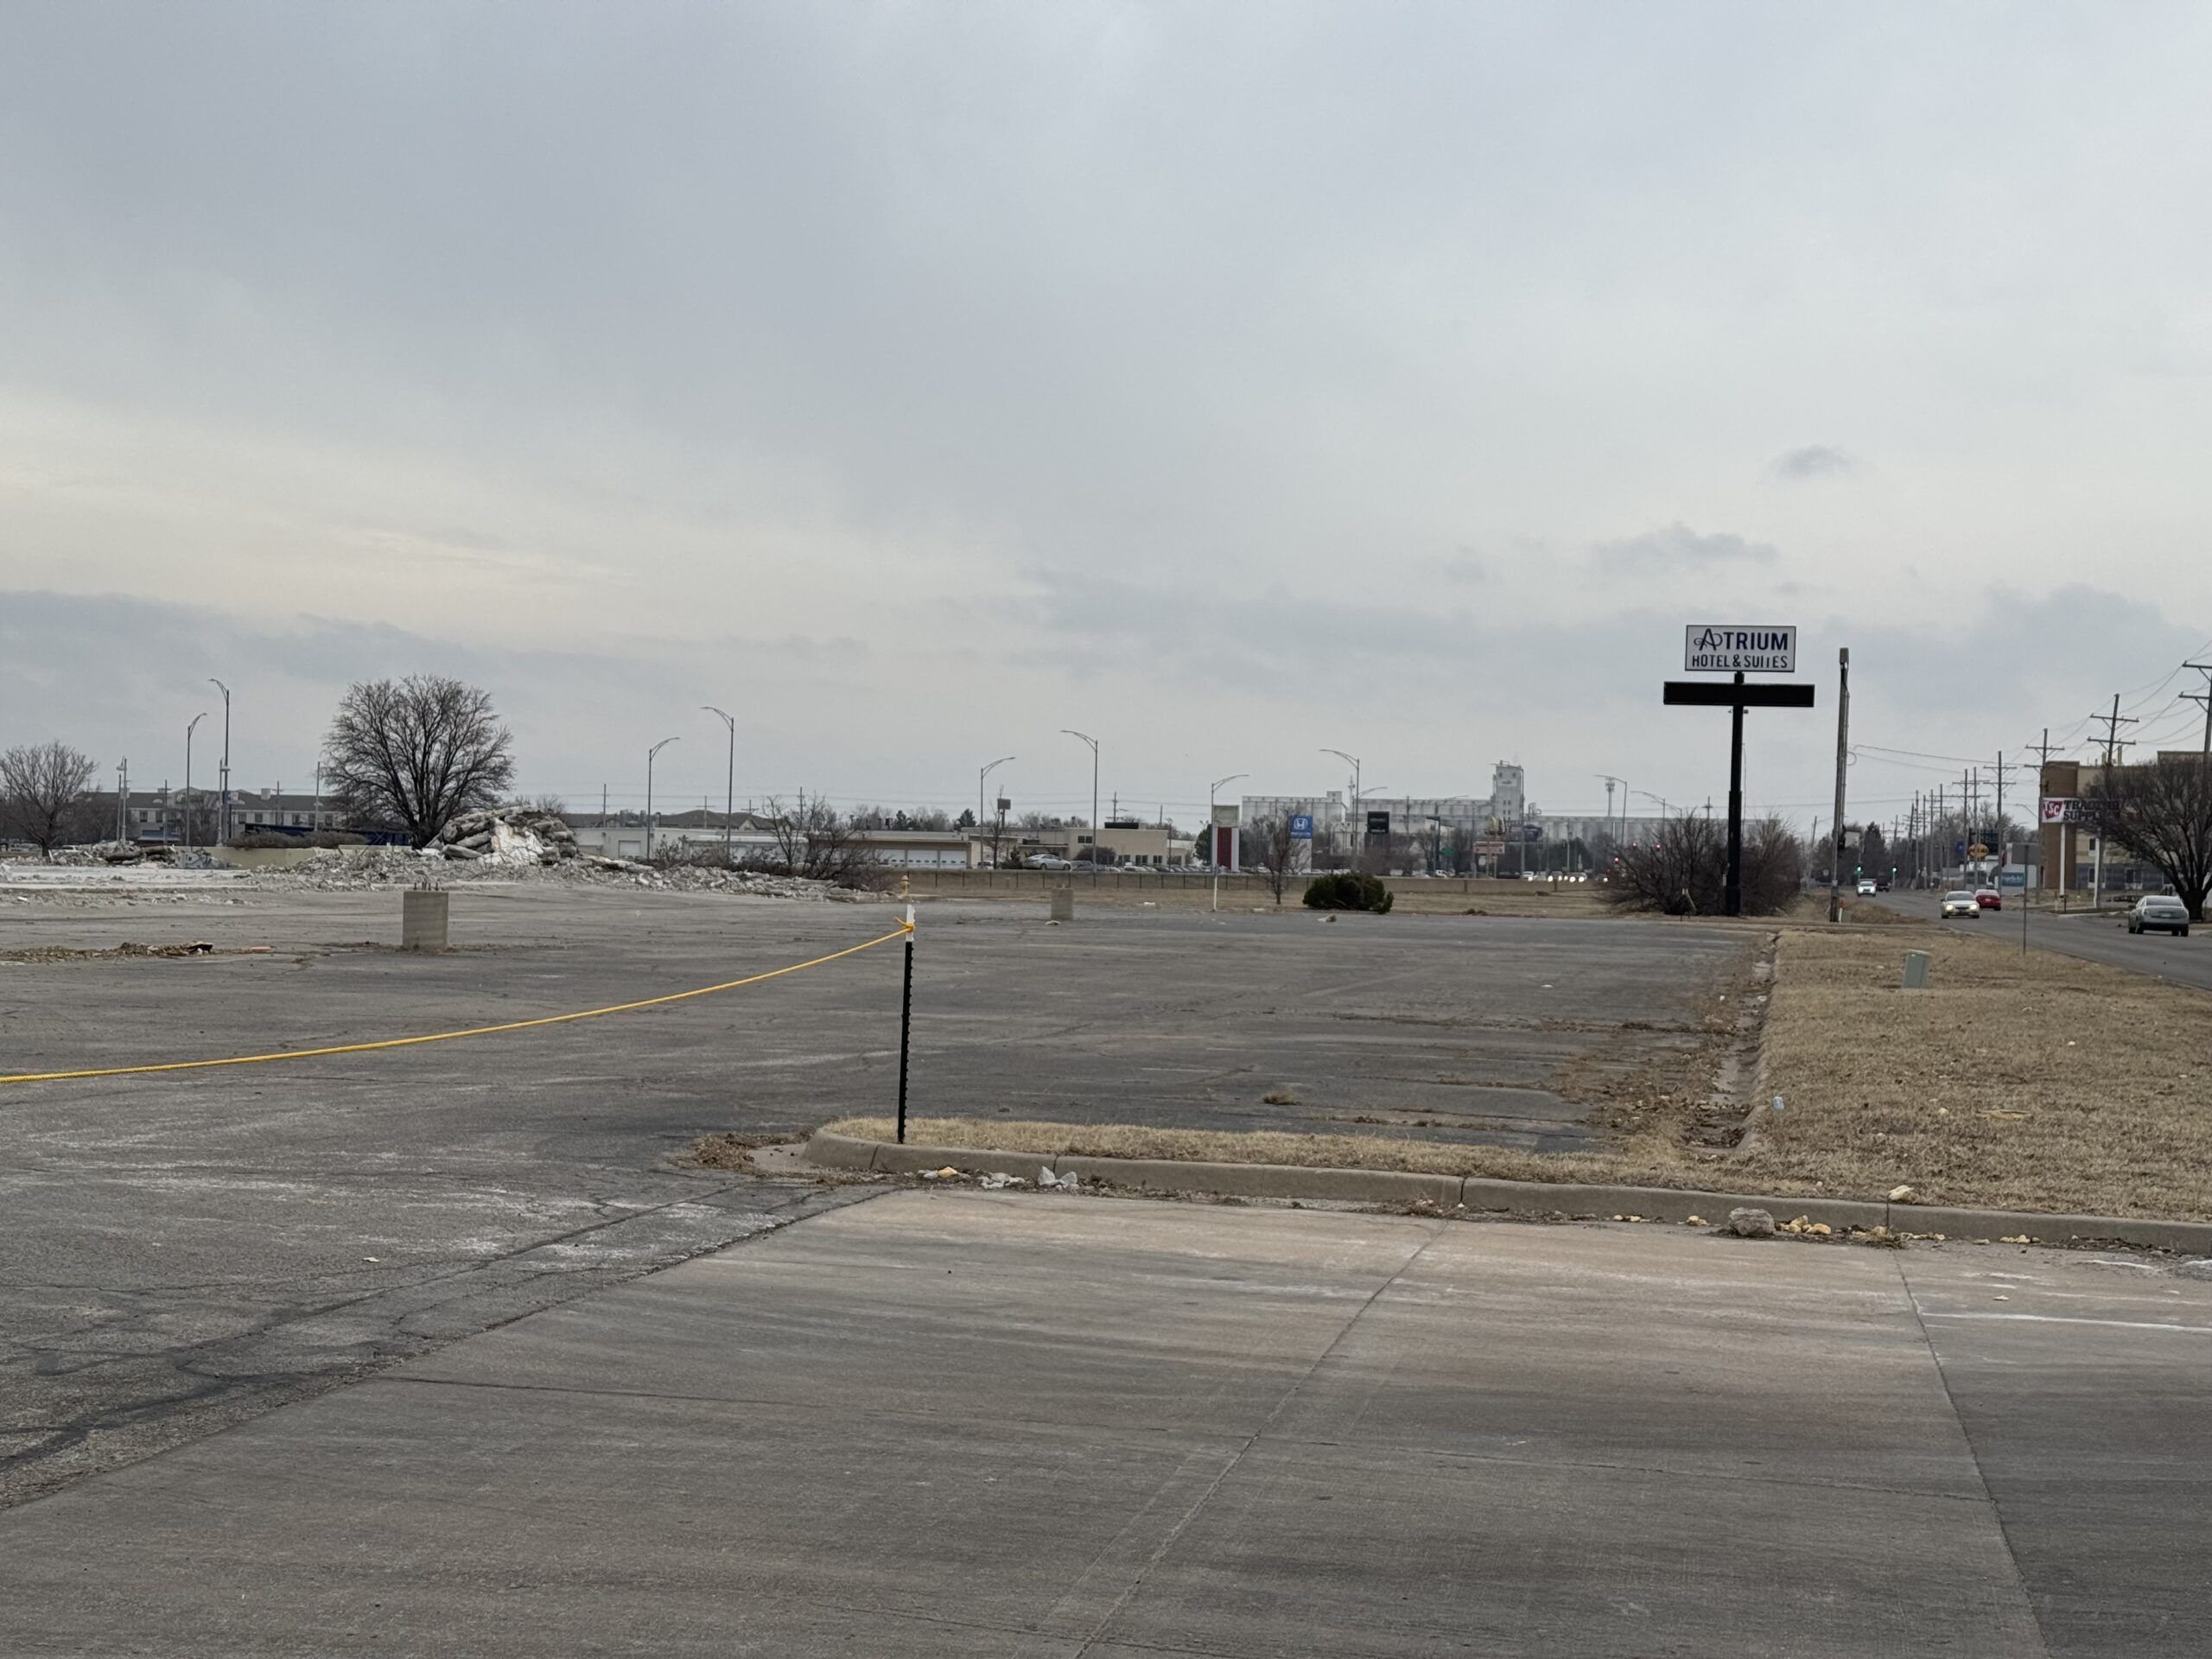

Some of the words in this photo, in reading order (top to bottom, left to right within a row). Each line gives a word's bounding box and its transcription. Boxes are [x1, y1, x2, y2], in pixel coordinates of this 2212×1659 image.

[1694, 628, 1788, 651] ATRIUM
[1692, 654, 1730, 667] HOTEL
[1732, 654, 1741, 668] &
[2044, 801, 2060, 815] TSC
